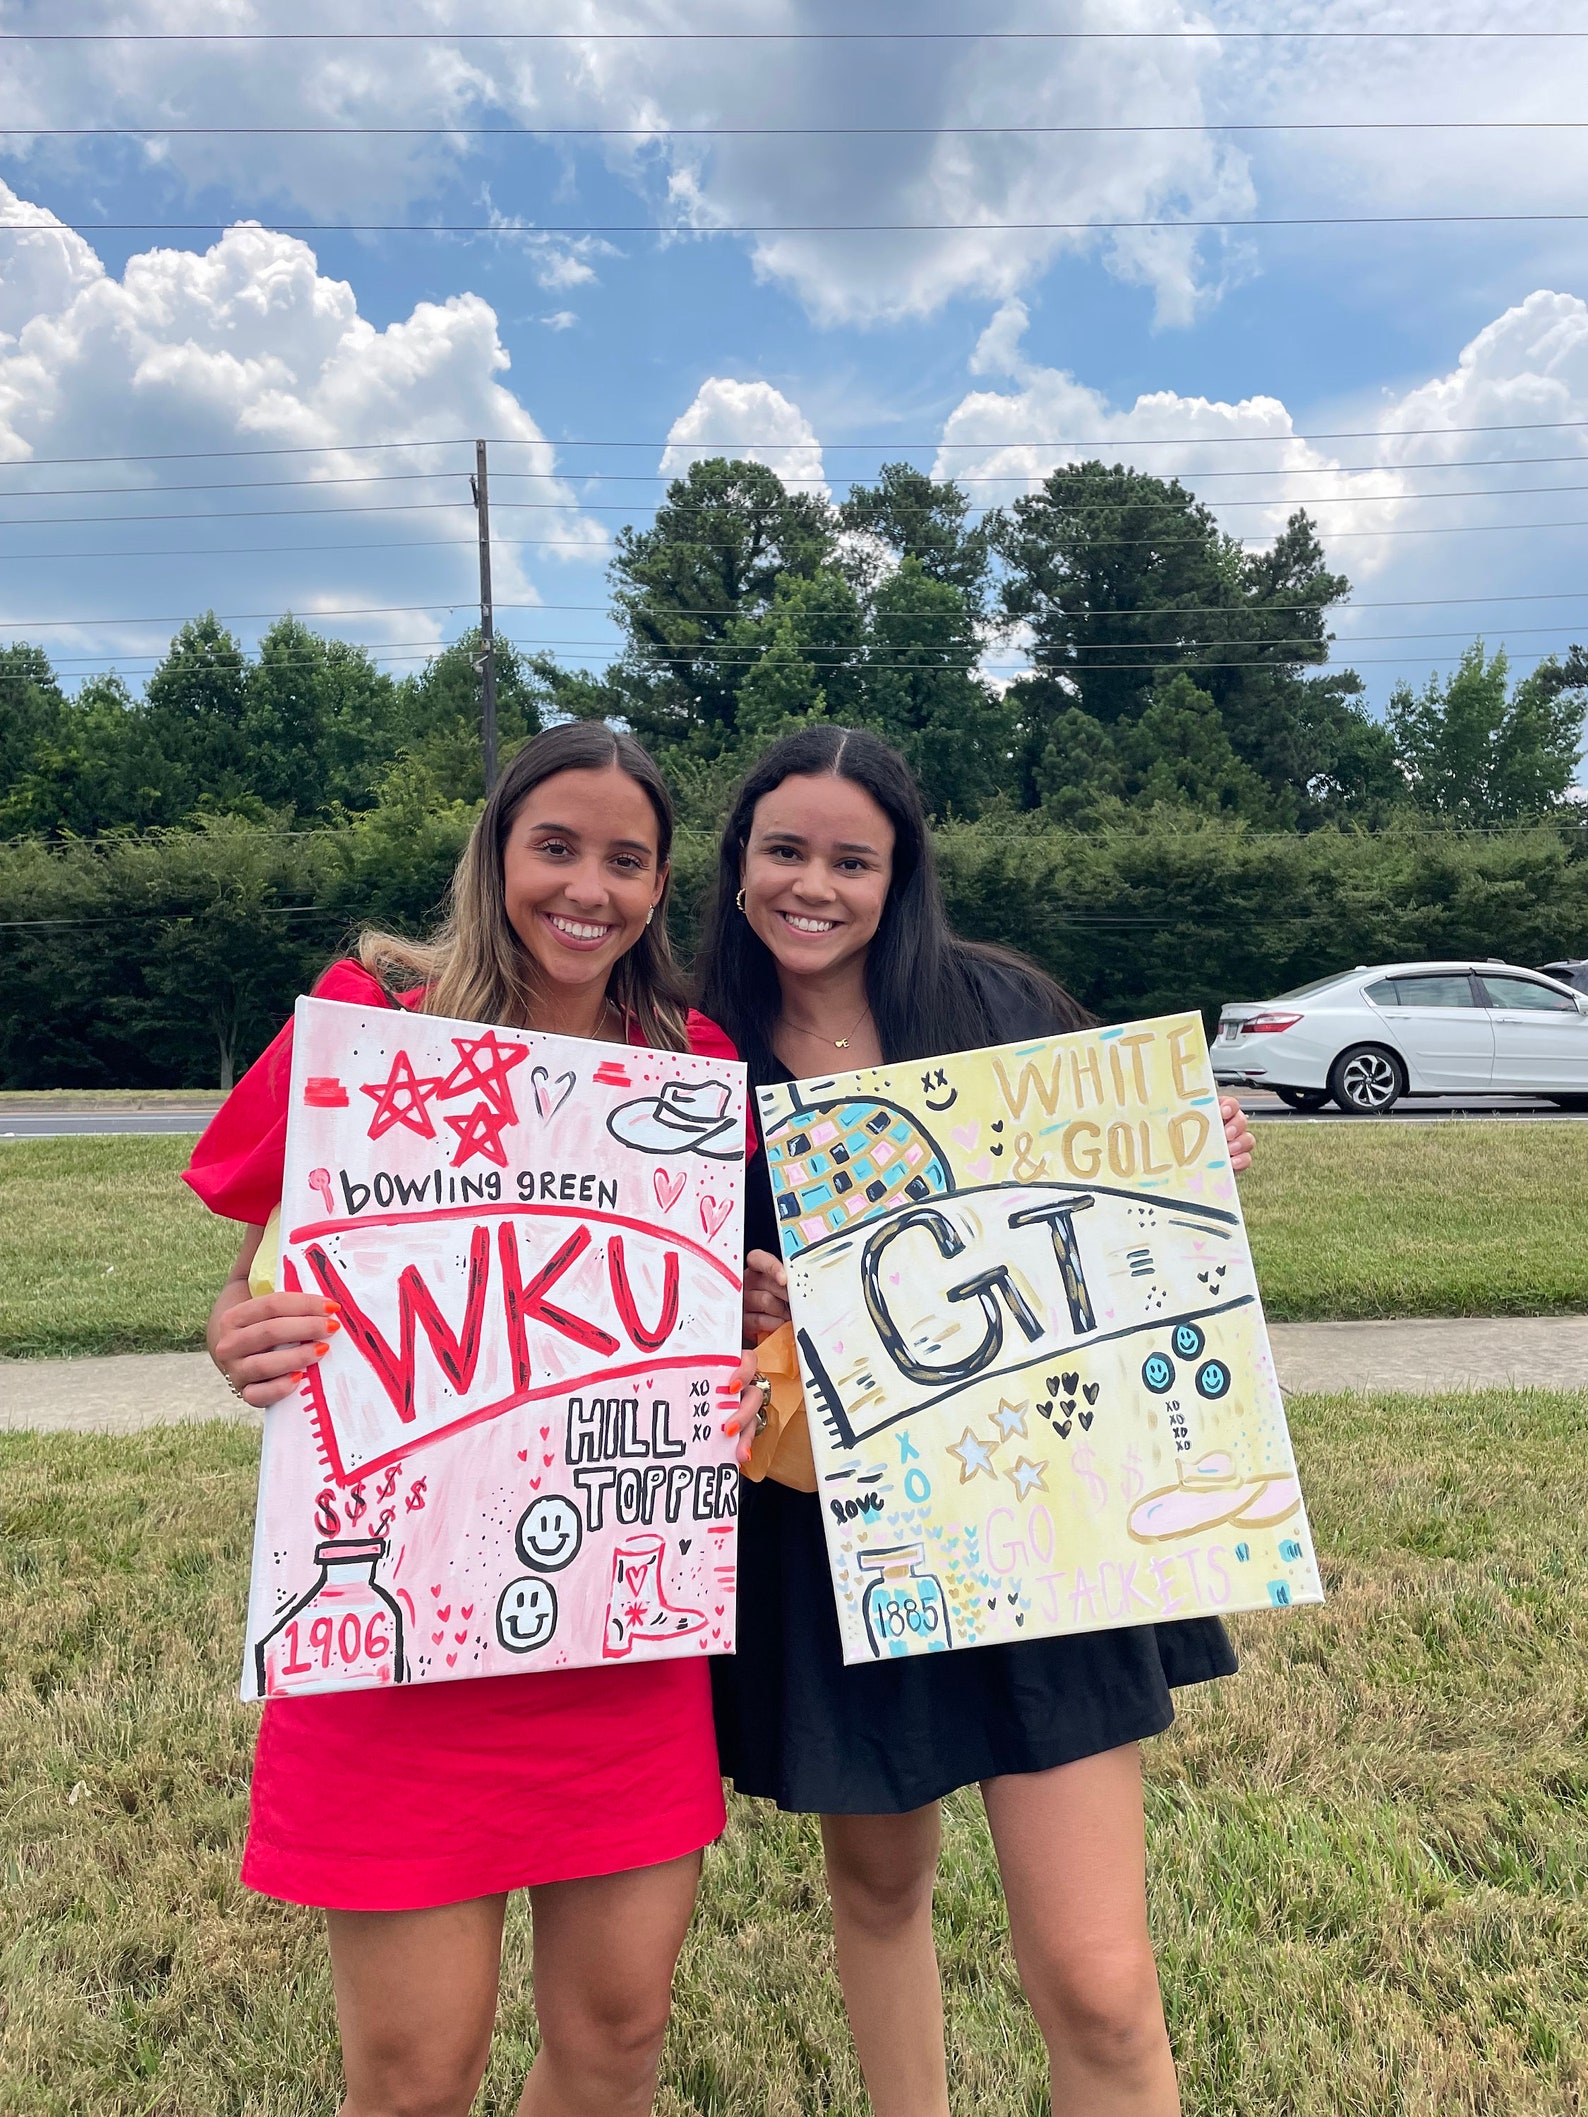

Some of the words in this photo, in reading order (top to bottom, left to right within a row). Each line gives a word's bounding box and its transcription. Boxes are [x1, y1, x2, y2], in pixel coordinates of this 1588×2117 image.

[993, 1024, 1209, 1119] WHITE
[1013, 1131, 1048, 1184] &
[1061, 1110, 1210, 1178] GOLD
[304, 1221, 679, 1423] WKU
[861, 1194, 1098, 1386] GT
[689, 1379, 710, 1397] XO
[693, 1401, 711, 1417] XO
[565, 1398, 686, 1465] HILL
[692, 1424, 712, 1442] XO
[574, 1463, 739, 1532] TOPPER
[985, 1506, 1057, 1574] GO
[1035, 1545, 1232, 1622] JACKETS
[283, 1612, 390, 1676] 1906
[875, 1599, 939, 1638] 1885
